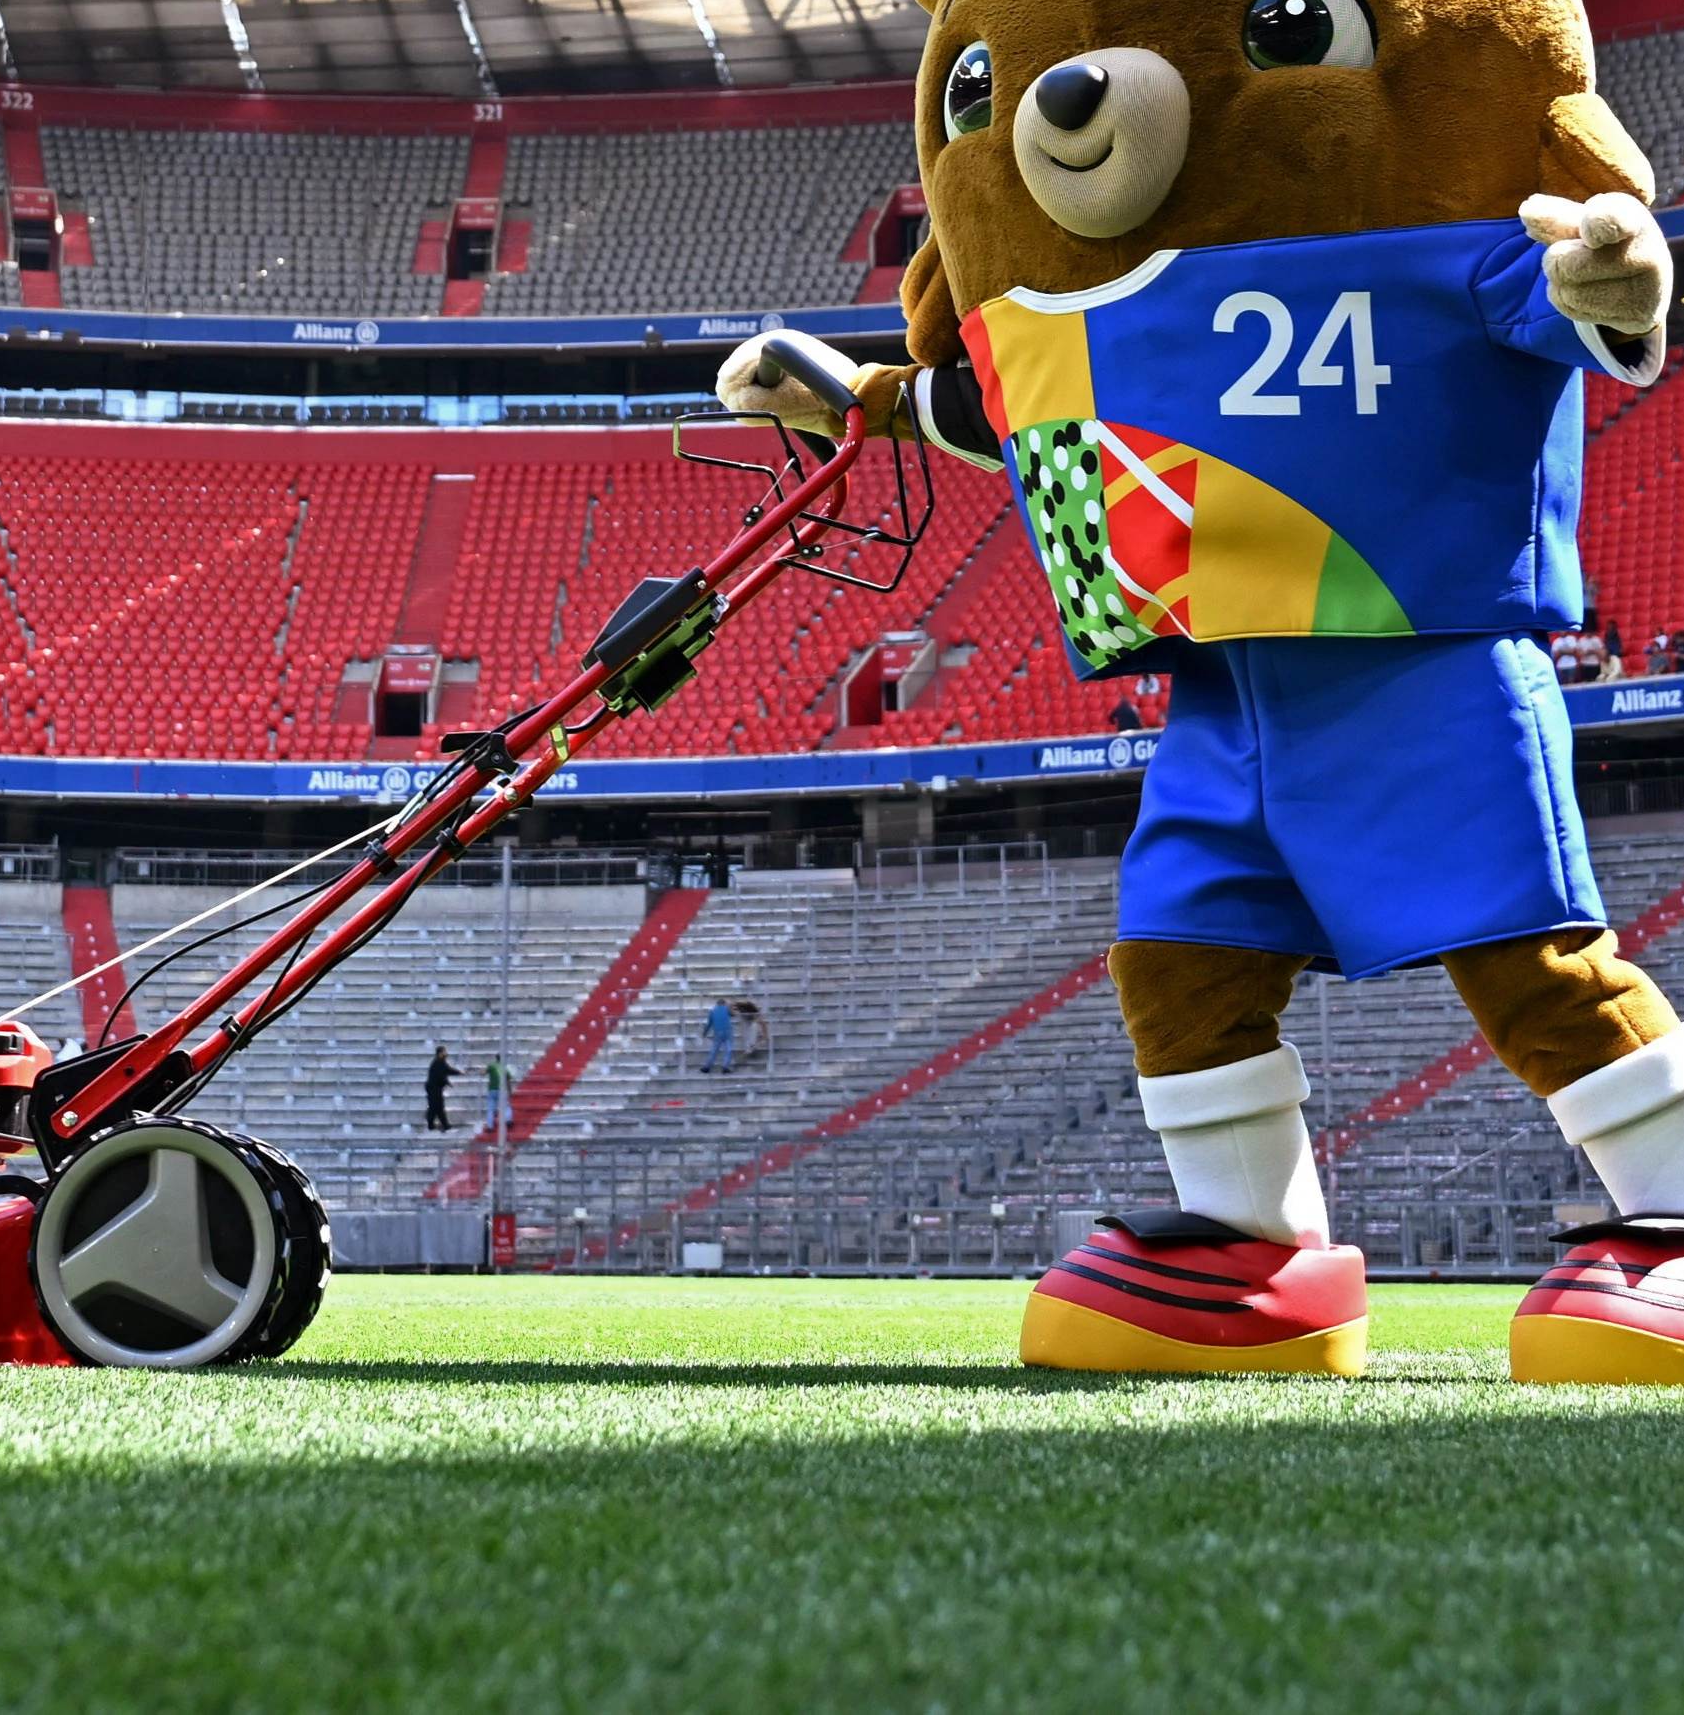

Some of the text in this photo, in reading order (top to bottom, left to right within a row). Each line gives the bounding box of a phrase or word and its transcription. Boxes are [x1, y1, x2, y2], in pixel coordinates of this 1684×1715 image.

[1, 90, 34, 110] 322
[474, 104, 503, 121] 321
[293, 322, 352, 341] Allianz
[698, 318, 757, 336] Allianz
[1212, 291, 1392, 416] 24
[1612, 687, 1681, 714] Allianz
[1040, 746, 1106, 768] Allianz
[308, 770, 380, 790] Allianz
